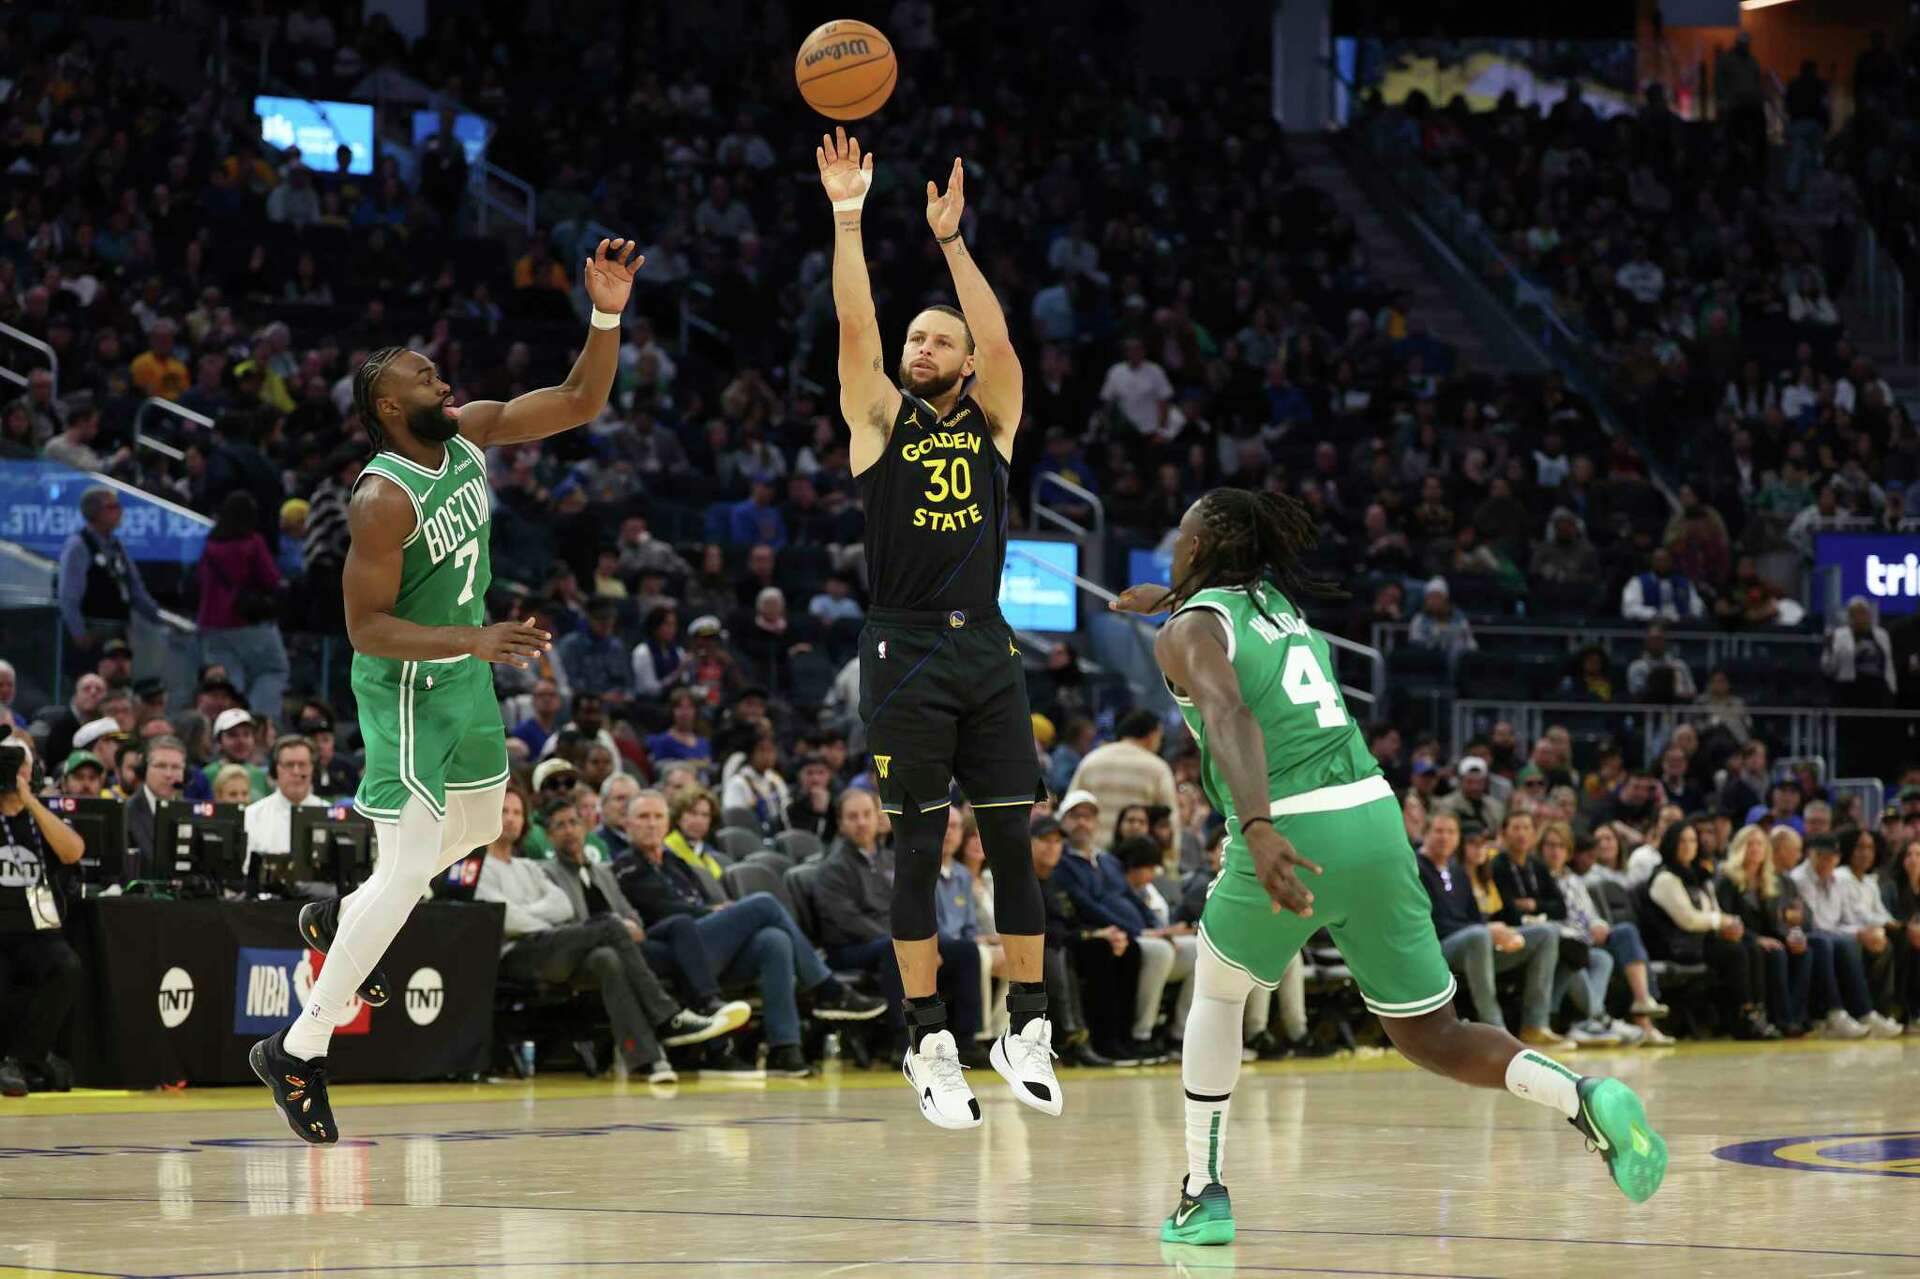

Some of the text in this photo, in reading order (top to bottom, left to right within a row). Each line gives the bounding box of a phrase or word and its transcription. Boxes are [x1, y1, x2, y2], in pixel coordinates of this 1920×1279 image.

[804, 39, 869, 67] Wilson
[902, 431, 981, 462] GOLDEN
[922, 457, 972, 503] 30
[423, 475, 490, 566] BOSTON
[913, 503, 983, 532] STATE
[454, 536, 480, 606] 7
[1866, 552, 1920, 597] tri
[1281, 645, 1349, 729] 4
[158, 987, 195, 1012] TNT
[246, 965, 290, 1017] NBA
[406, 987, 445, 1009] TNT
